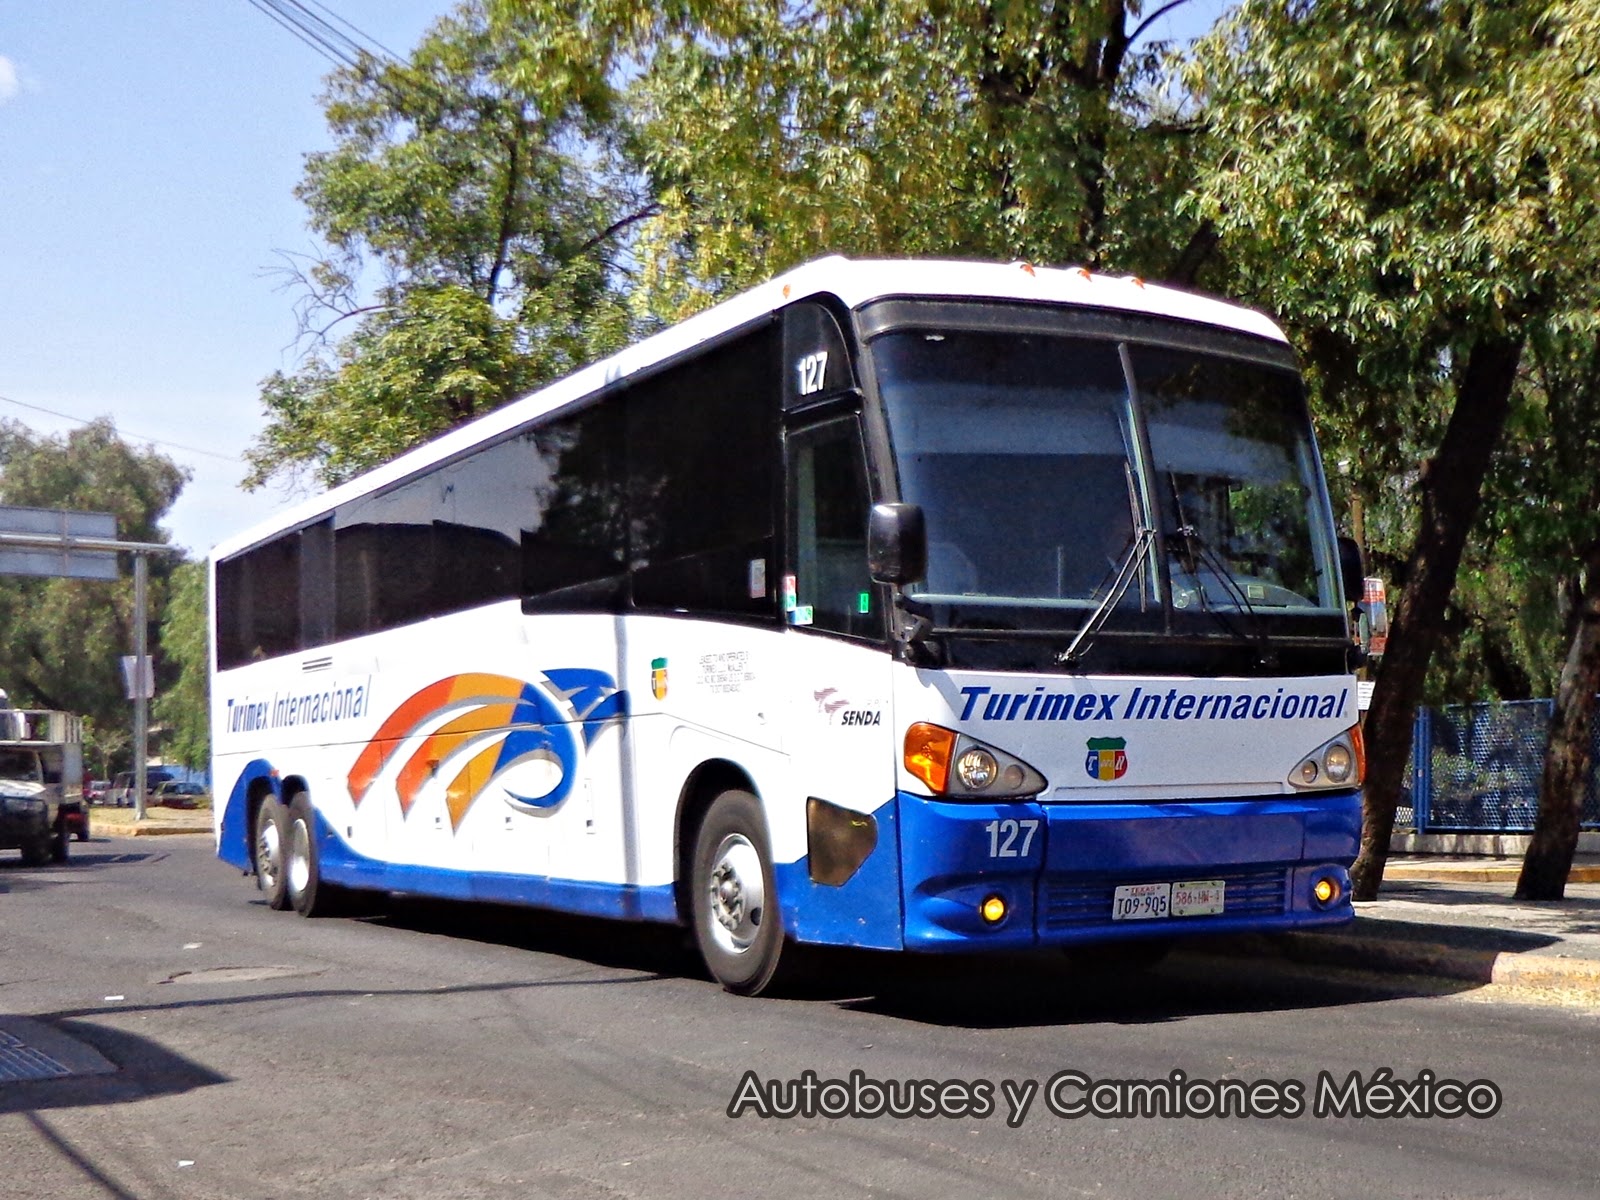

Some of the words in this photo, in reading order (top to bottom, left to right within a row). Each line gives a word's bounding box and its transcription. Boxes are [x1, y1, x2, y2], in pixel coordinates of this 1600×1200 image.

[798, 352, 828, 395] 127
[227, 695, 270, 734] Turimex
[271, 674, 372, 729] Internacional
[841, 710, 881, 726] SENDA
[960, 686, 1119, 721] Turimex
[1122, 687, 1347, 720] Internacional
[985, 819, 1039, 858] 127
[1131, 885, 1156, 893] TEXAS
